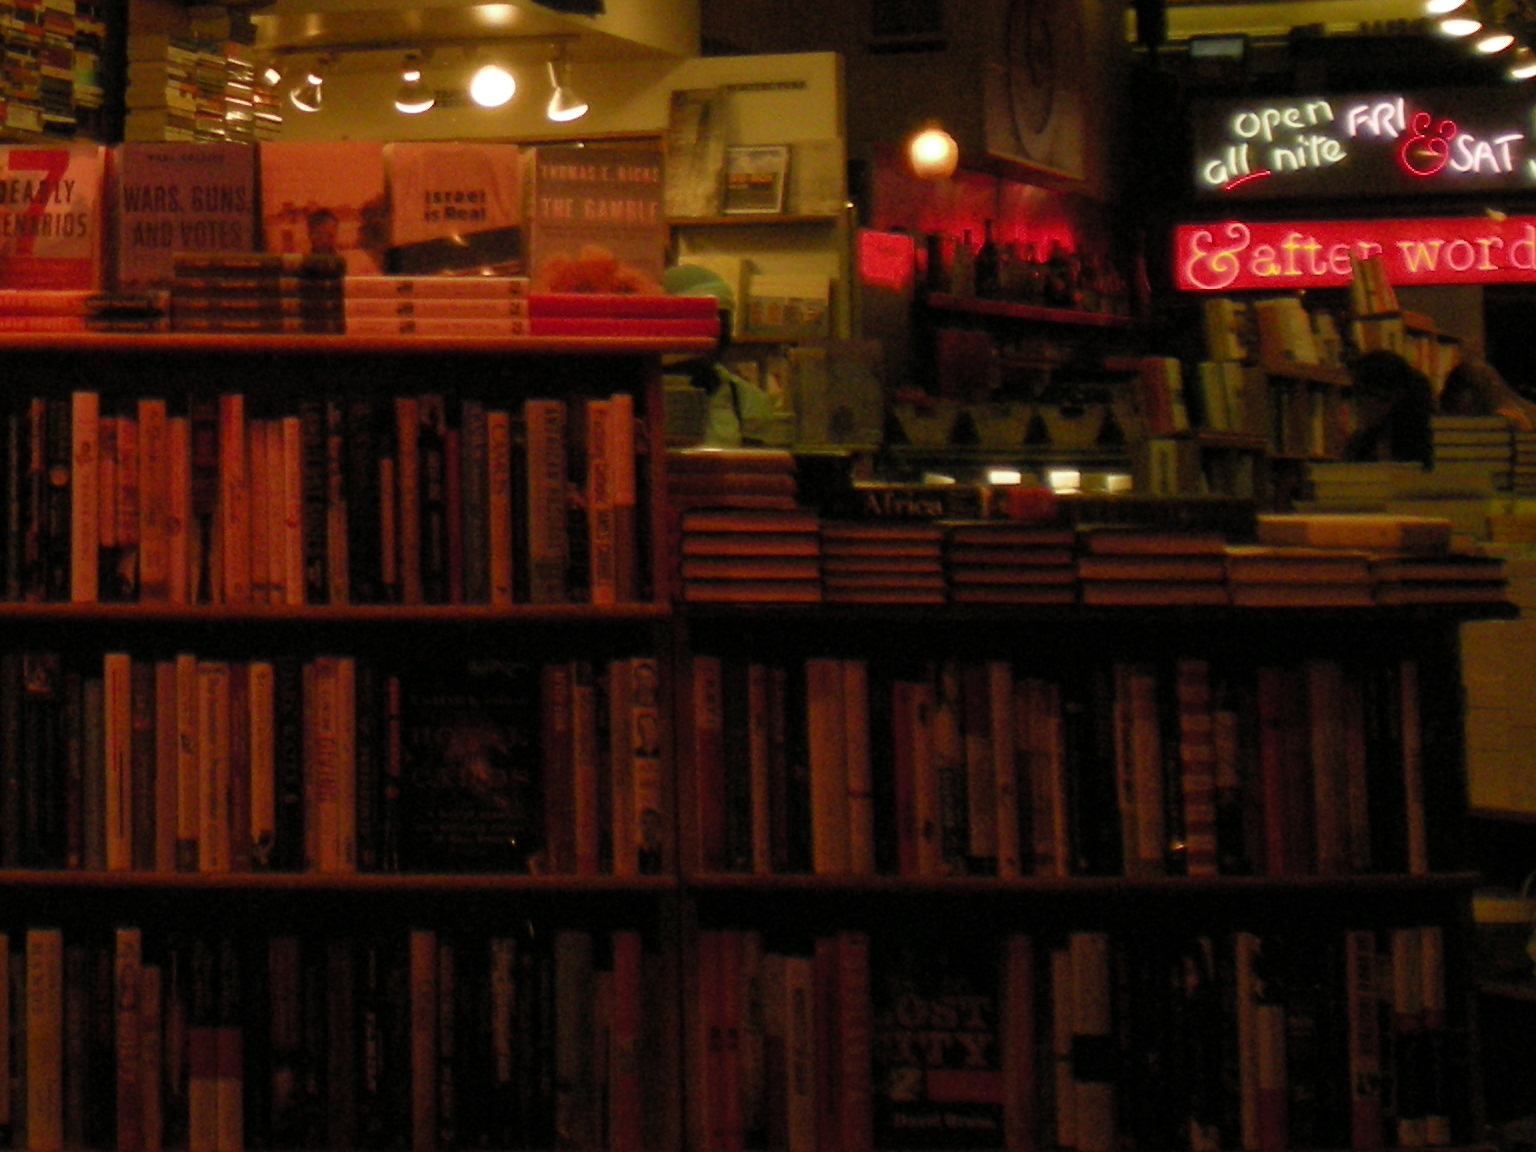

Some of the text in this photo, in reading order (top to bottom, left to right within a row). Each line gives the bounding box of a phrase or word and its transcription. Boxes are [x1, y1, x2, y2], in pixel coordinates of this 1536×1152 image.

[1202, 134, 1348, 185] all nite
[1345, 96, 1407, 139] FRI
[1401, 111, 1457, 176] &
[1449, 134, 1524, 174] SAT
[133, 220, 243, 249] AND VOTES
[539, 197, 660, 222] THE GAMBLE
[1186, 222, 1251, 290] &
